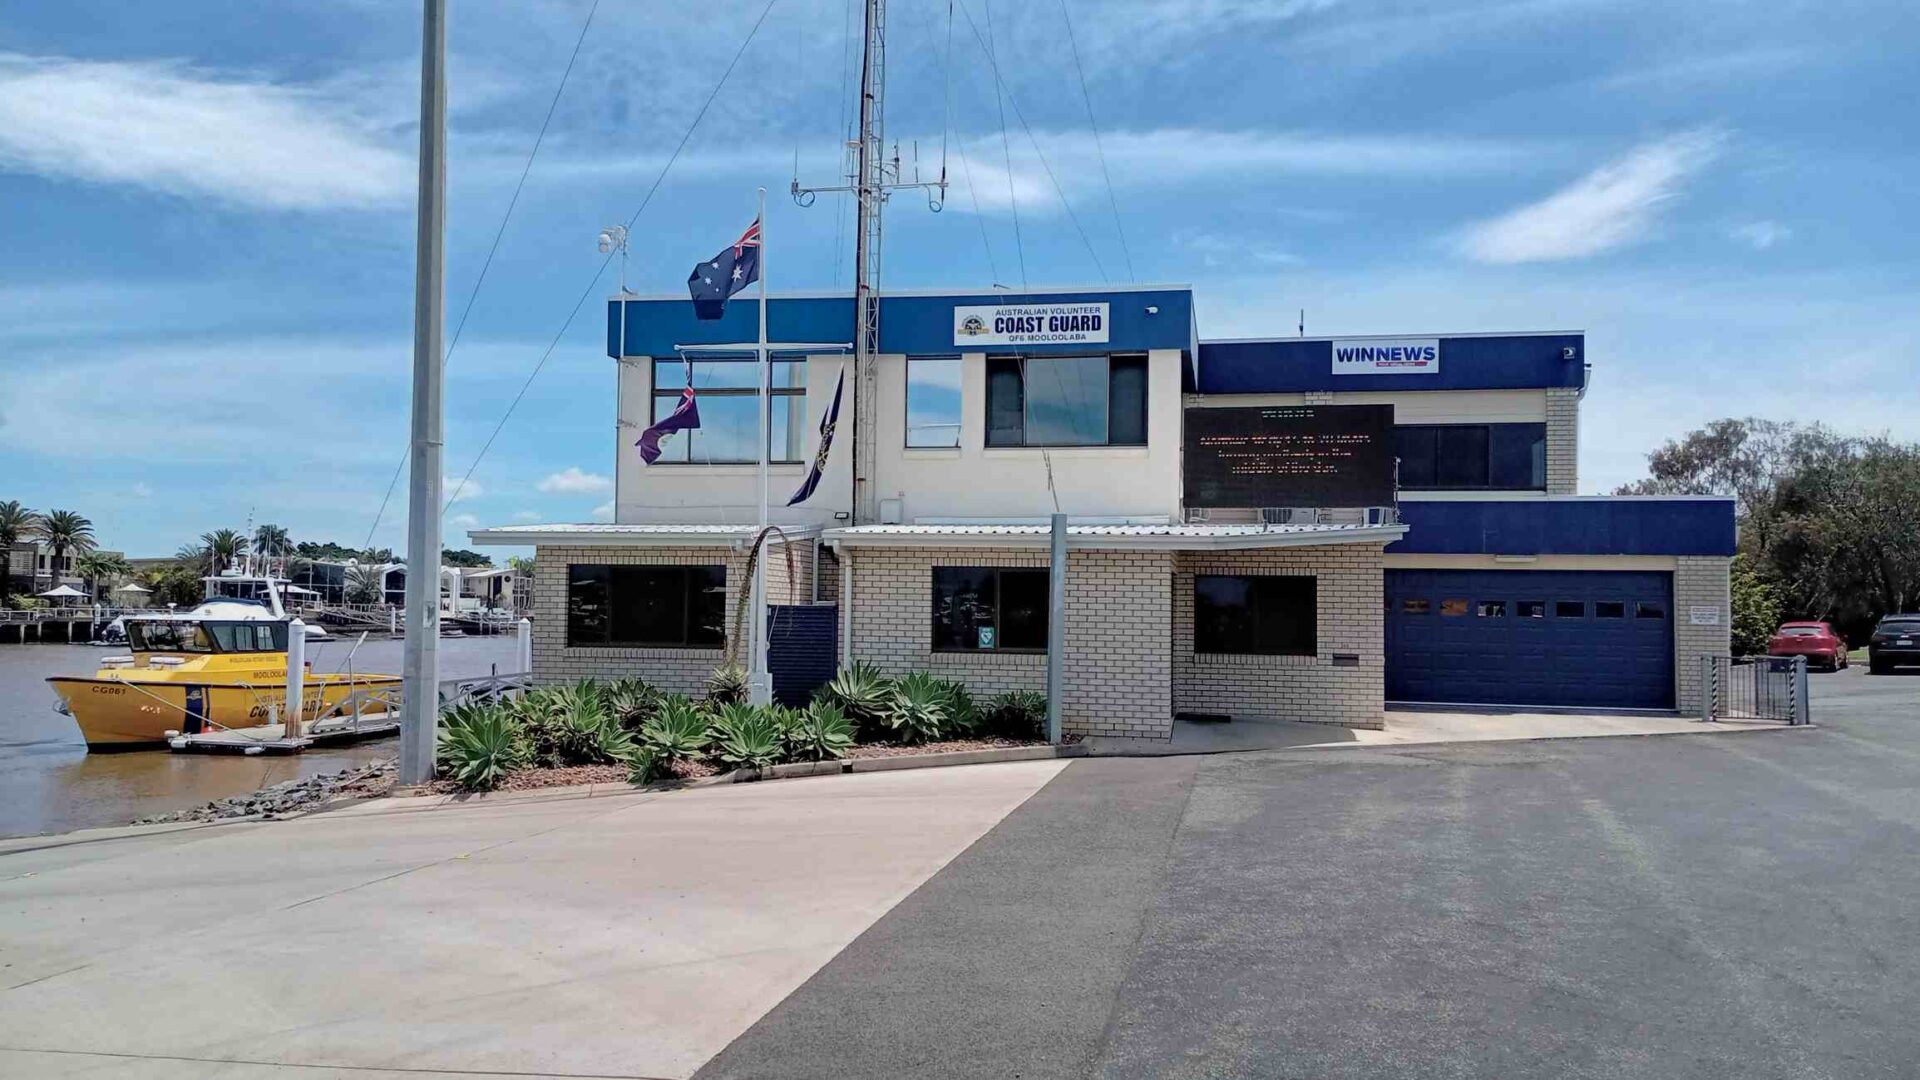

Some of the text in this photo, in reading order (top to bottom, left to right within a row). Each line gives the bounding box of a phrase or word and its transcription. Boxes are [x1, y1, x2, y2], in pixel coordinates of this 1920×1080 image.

[995, 306, 1101, 316] AUSTRALIAN VOLUNTEER
[994, 316, 1045, 334] COAST
[1048, 315, 1101, 333] GUARD
[1027, 333, 1087, 342] MOOLOOLABA
